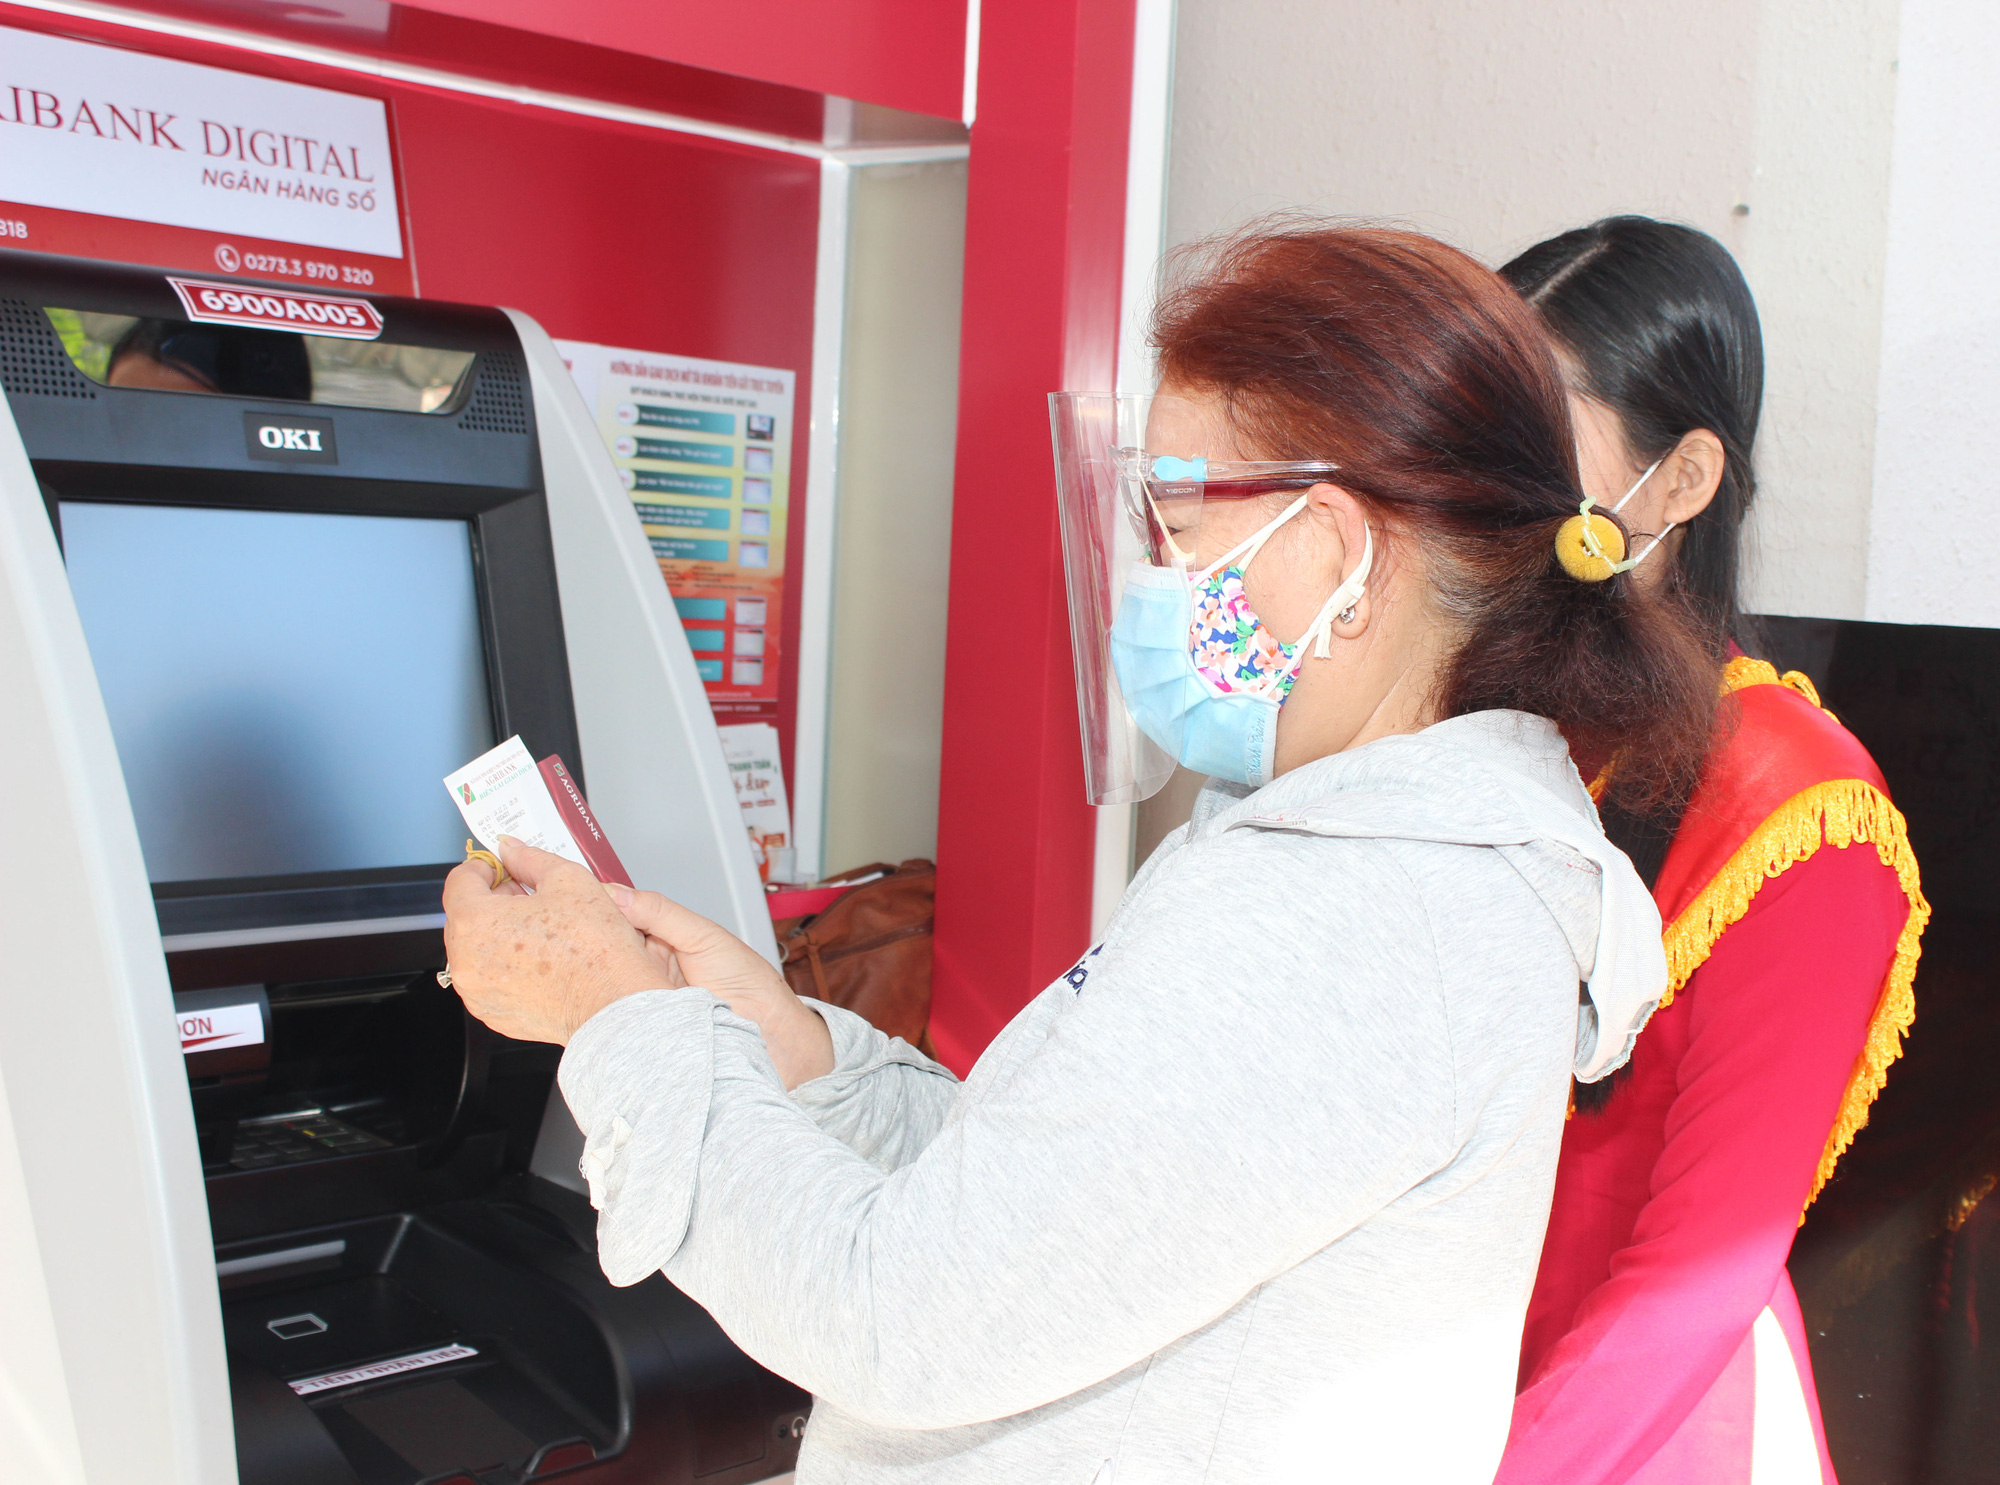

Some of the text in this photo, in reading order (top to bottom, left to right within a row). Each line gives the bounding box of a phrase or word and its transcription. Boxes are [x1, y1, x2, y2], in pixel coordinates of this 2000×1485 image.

[199, 121, 375, 184] DIGITAL
[202, 168, 377, 213] NGÂN HÀNG SỐ
[244, 252, 374, 287] 0273.3 970 320
[200, 289, 367, 327] 6900A005
[259, 426, 323, 452] OKI
[560, 777, 602, 842] AGRIBANK
[178, 1016, 213, 1037] ƠN
